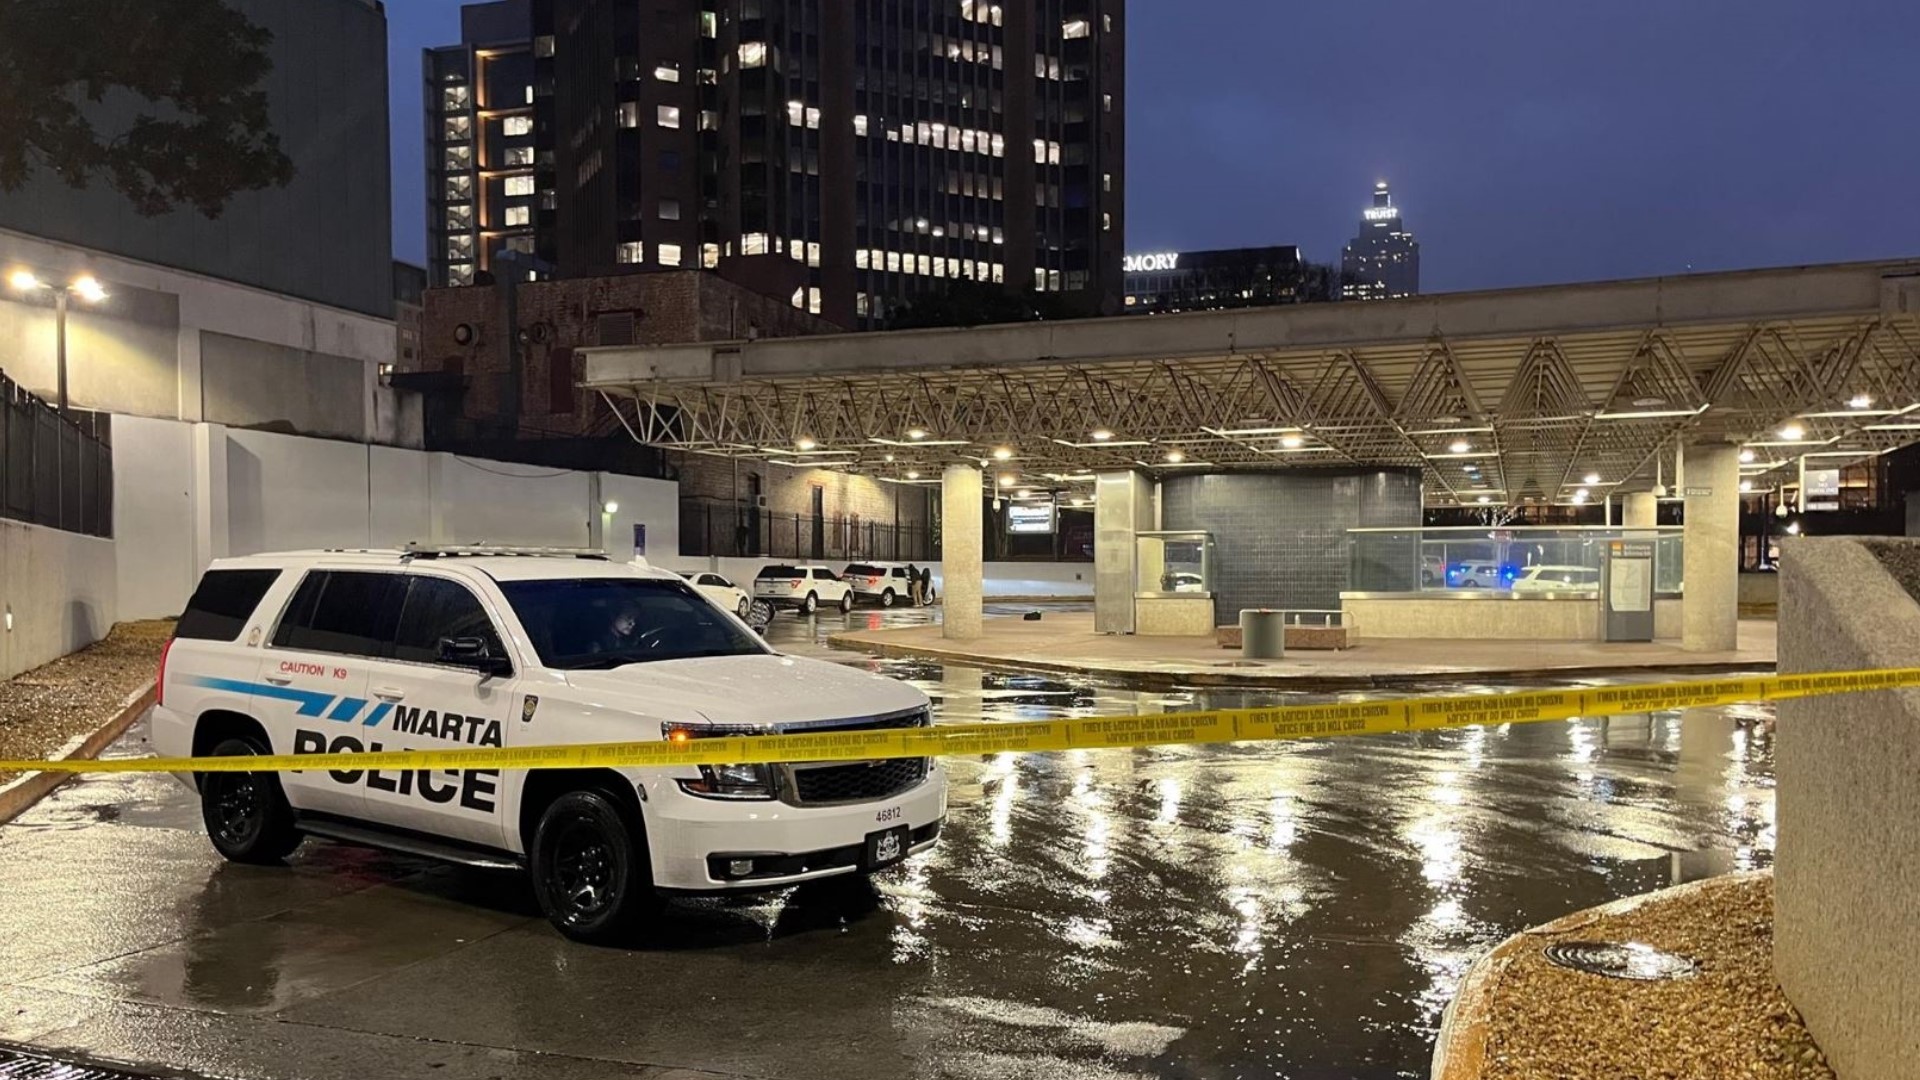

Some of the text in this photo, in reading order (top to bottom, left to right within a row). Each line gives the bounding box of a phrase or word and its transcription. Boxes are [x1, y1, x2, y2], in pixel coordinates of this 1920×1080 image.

[1364, 208, 1398, 220] TRUIST
[280, 661, 347, 679] CAUTION K9
[392, 705, 502, 748] MARTA
[876, 807, 901, 822] 46812
